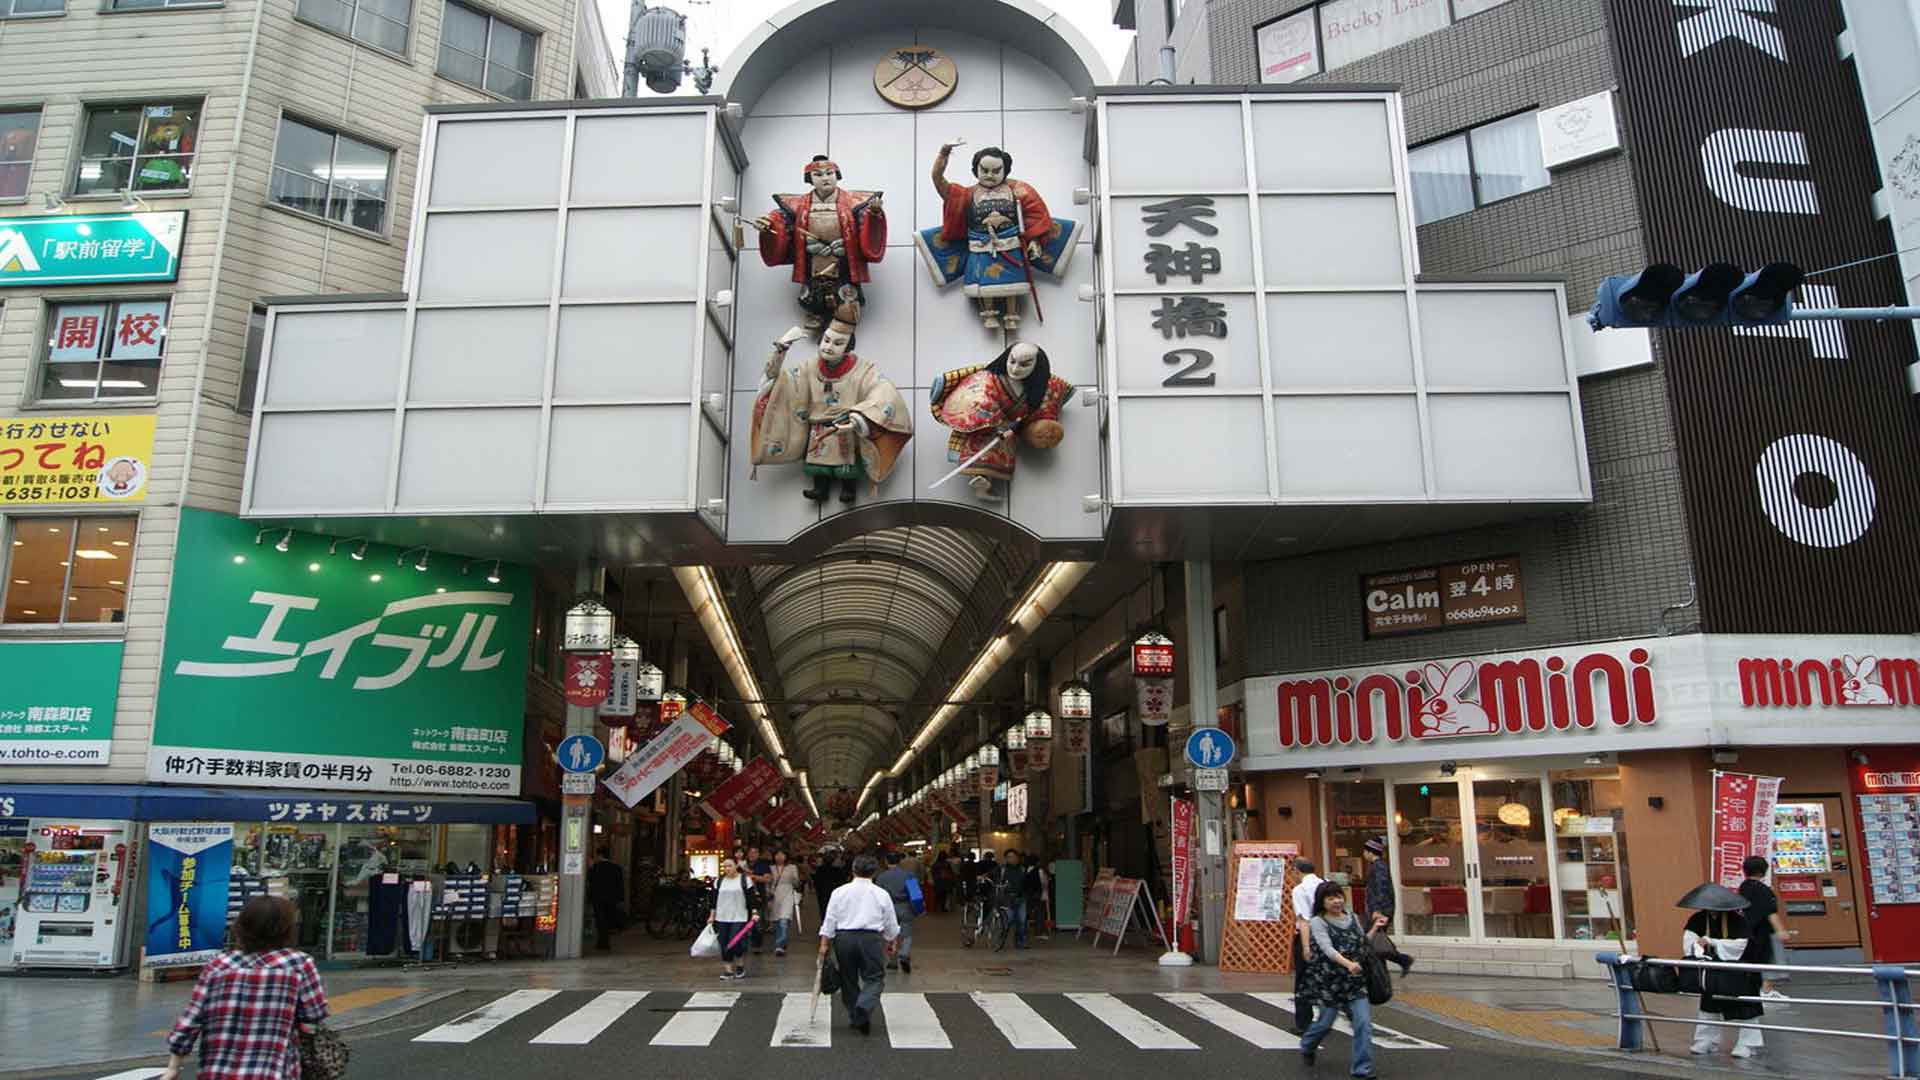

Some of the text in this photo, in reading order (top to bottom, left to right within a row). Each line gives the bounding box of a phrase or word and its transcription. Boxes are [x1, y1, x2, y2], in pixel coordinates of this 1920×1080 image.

[1141, 196, 1228, 388] 天神橋2
[0, 422, 111, 440] 行かせない
[1366, 585, 1440, 613] Calm
[174, 591, 515, 690] エイブル
[1476, 646, 1658, 736] mini
[165, 755, 373, 783] 仲介手数料家賃の半月分
